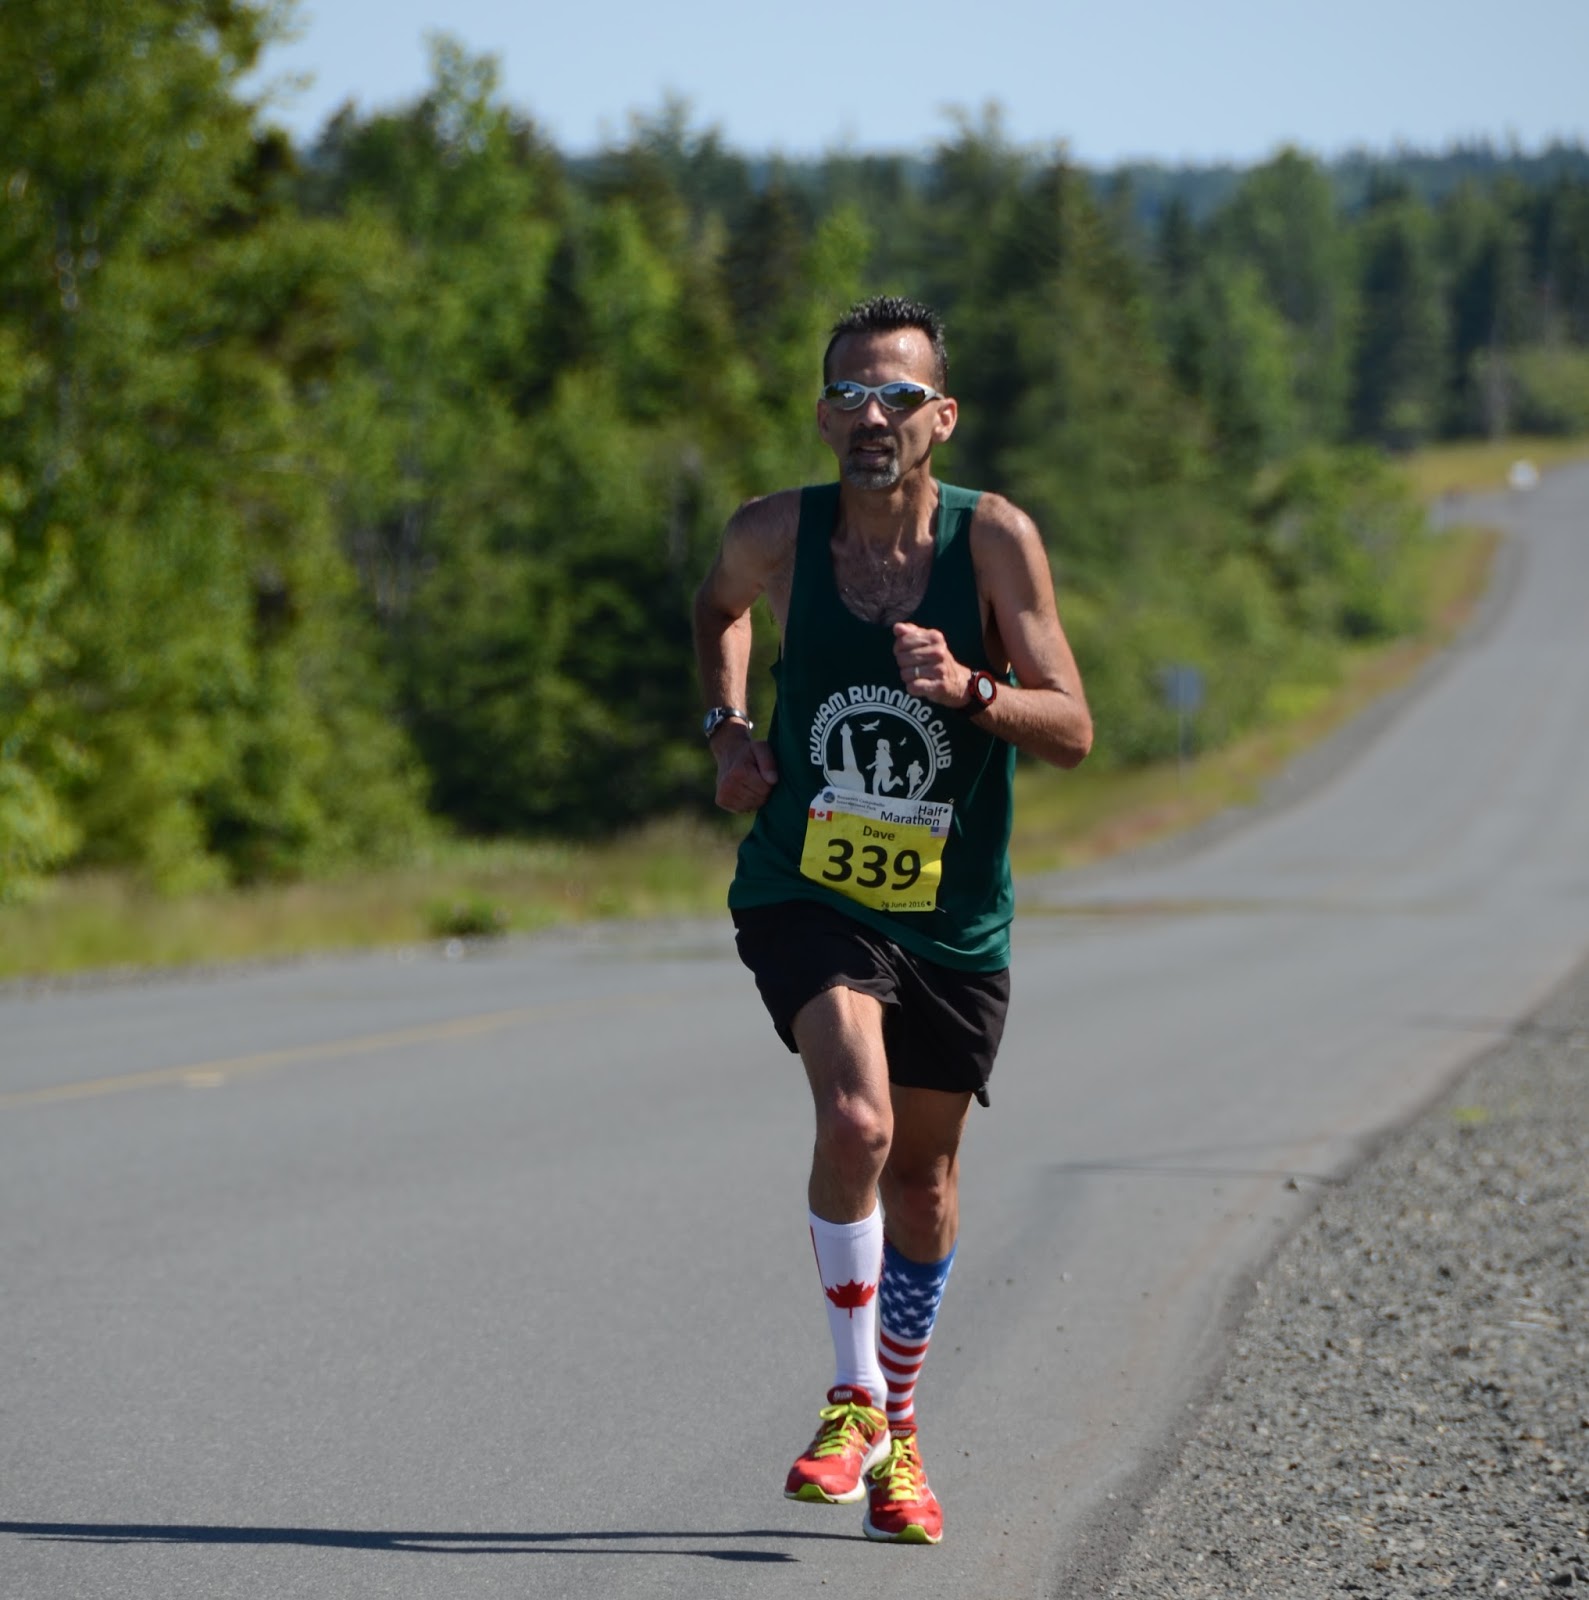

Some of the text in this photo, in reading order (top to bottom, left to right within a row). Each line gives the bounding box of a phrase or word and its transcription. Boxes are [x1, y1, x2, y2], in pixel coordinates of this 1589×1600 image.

[809, 685, 952, 769] DUNHAM RUNNING CLUB
[880, 811, 940, 826] Marathon
[918, 805, 943, 817] Half
[863, 825, 895, 841] Dave
[822, 838, 921, 891] 339
[891, 901, 907, 909] June
